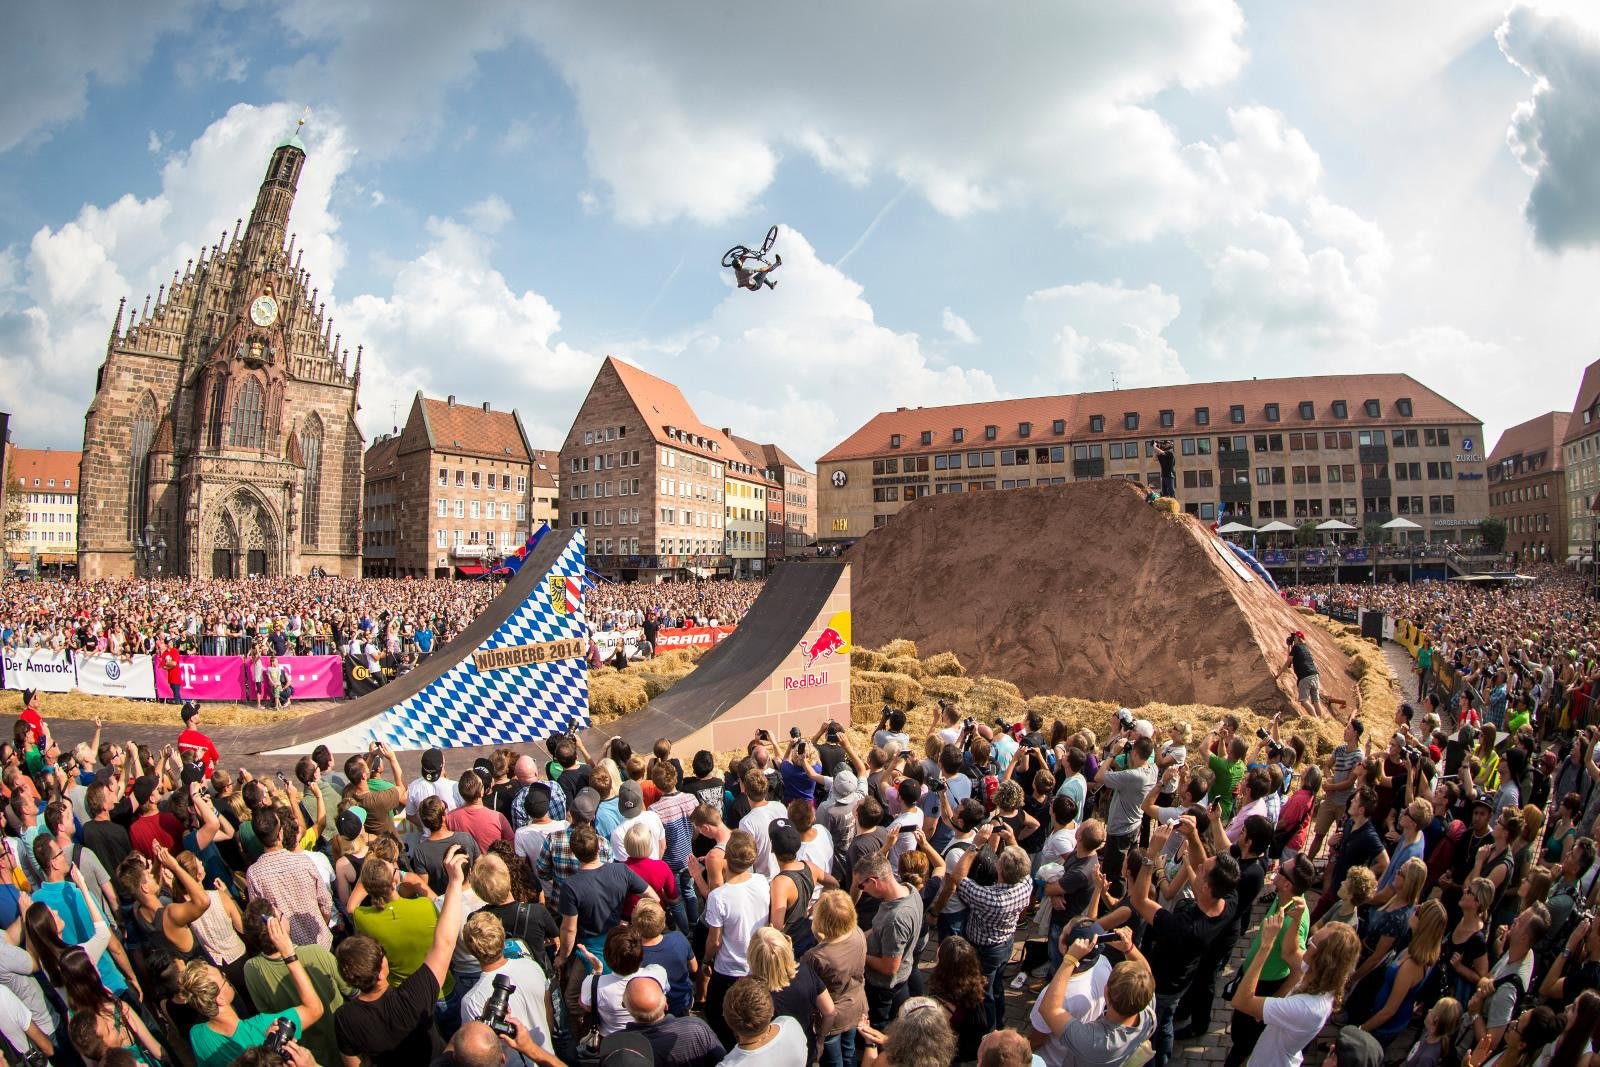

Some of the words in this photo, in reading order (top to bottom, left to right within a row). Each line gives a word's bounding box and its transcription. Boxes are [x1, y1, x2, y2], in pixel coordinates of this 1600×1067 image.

[1456, 454, 1483, 462] ZURICH
[657, 633, 711, 645] SRAM
[478, 646, 545, 669] NÜRNBERG
[549, 641, 582, 659] 2014
[5, 657, 22, 671] Der
[26, 658, 73, 673] Amarok.
